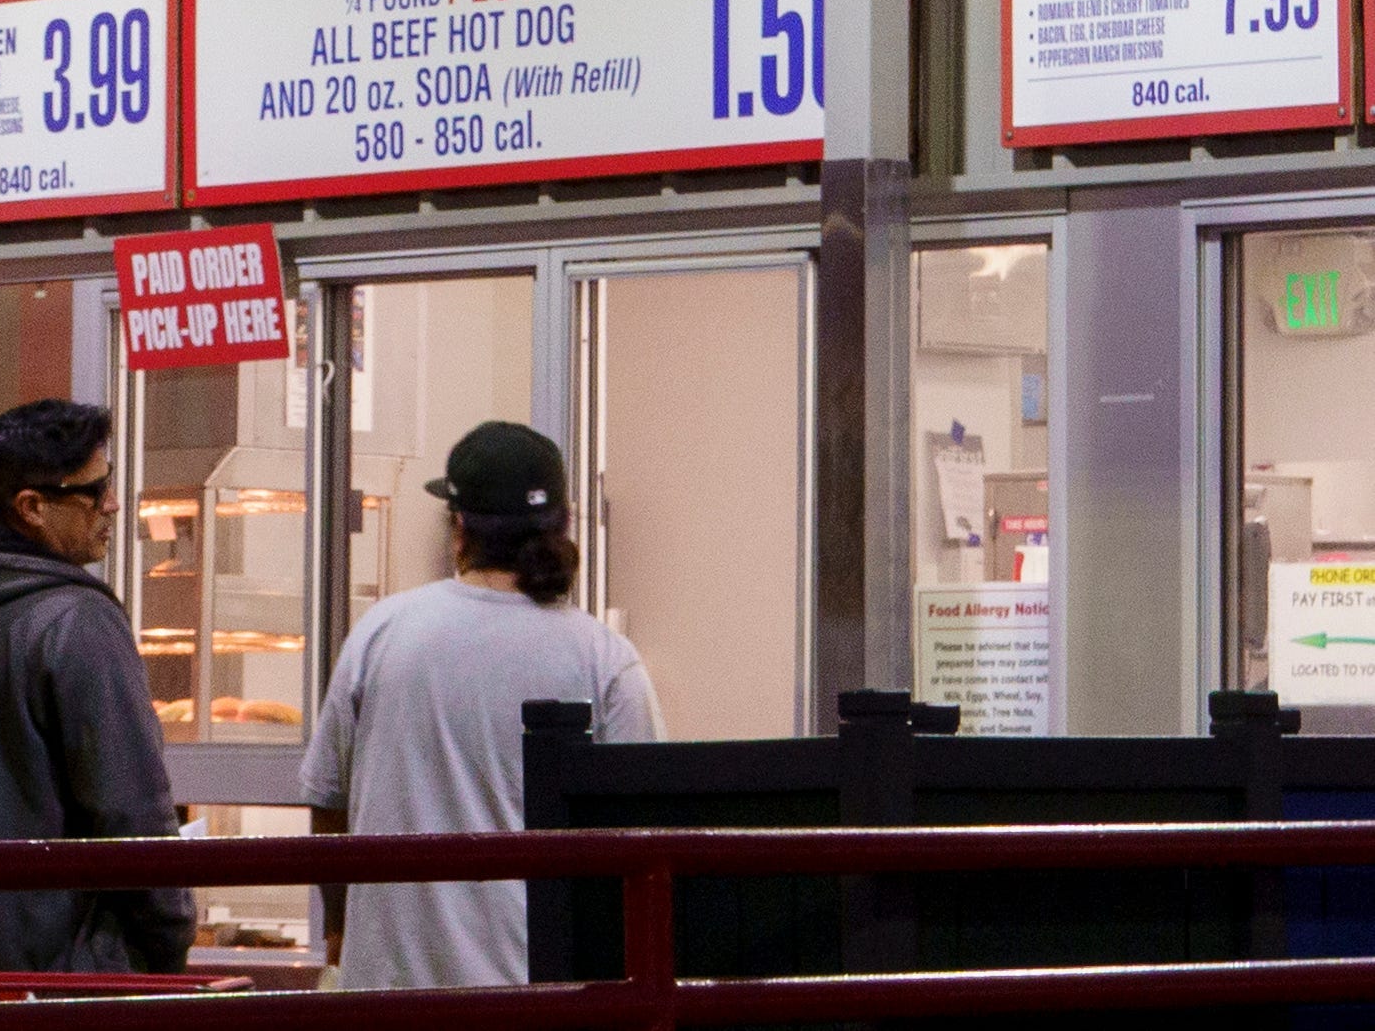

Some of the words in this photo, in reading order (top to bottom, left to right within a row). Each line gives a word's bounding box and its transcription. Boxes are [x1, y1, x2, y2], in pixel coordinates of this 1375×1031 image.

[311, 24, 360, 66] ALL
[372, 17, 437, 60] BEEF
[449, 11, 505, 53] HOT
[516, 4, 575, 48] DOG
[43, 7, 150, 133] 3.99
[259, 79, 315, 120] AND
[325, 75, 357, 115] 20
[367, 80, 404, 112] oz.
[416, 63, 492, 108] SODA
[503, 65, 563, 108] (With
[571, 57, 641, 97] Refill)
[1132, 80, 1169, 106] 840
[1175, 78, 1210, 103] cal.
[355, 121, 404, 162] 580
[435, 114, 483, 156] 850
[494, 110, 542, 151] cal.
[38, 161, 74, 189] cal.
[131, 250, 186, 297] PAID
[189, 242, 265, 291] ORDER
[127, 303, 218, 352] PICK-UP
[222, 297, 282, 344] HERE
[1286, 271, 1340, 329] EXIT
[1292, 592, 1317, 607] PAY
[1321, 592, 1363, 606] FIRST
[1310, 568, 1350, 583] PHONE
[928, 604, 960, 617] Food
[964, 603, 1011, 619] Allergy
[1292, 664, 1339, 676] LOCATED
[1344, 664, 1358, 676] TO
